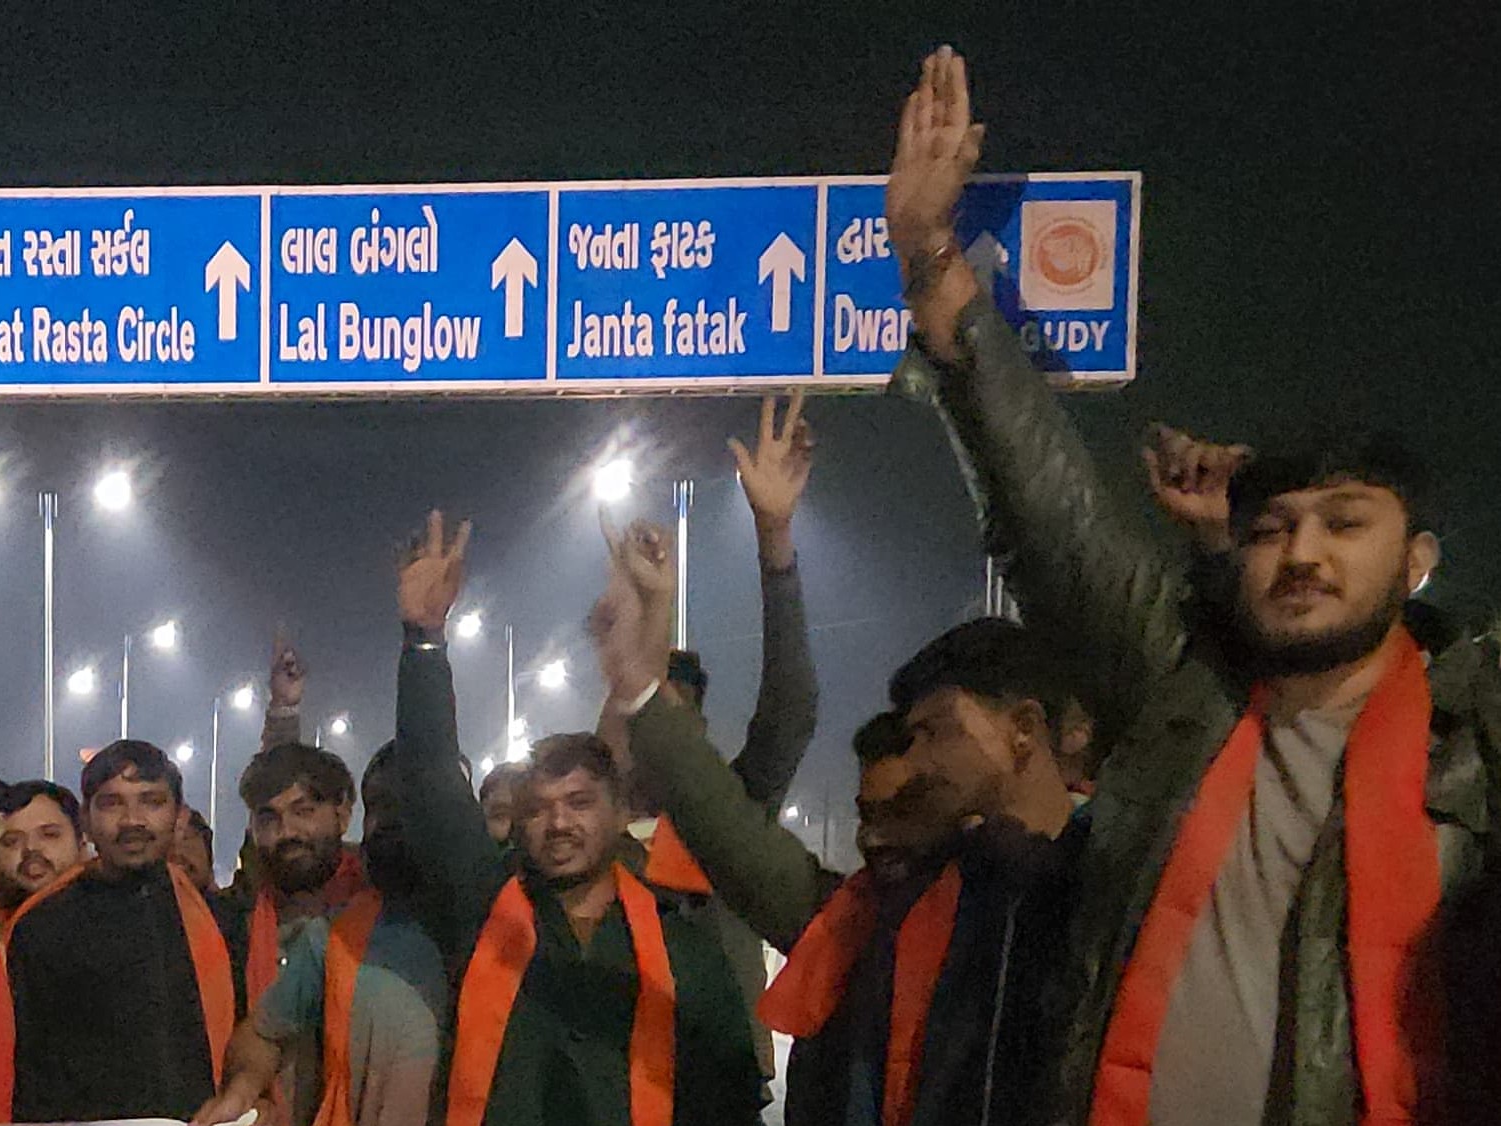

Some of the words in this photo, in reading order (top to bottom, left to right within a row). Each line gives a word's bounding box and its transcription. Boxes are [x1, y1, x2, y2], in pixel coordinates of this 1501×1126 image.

[23, 230, 81, 276] રસ્તા
[91, 208, 150, 276] સર્કલ
[281, 227, 337, 274] લાલ
[350, 205, 438, 274] બંગલો
[569, 223, 639, 270] જનતા
[651, 220, 716, 279] ફાટક
[837, 217, 891, 264] દ્વાર
[33, 307, 107, 363] Rasta
[117, 306, 195, 363] Circle
[279, 303, 328, 361] Lal
[339, 302, 481, 373] Bunglow
[568, 300, 654, 358] Janta
[663, 297, 747, 356] fatak
[834, 294, 912, 353] Dwar
